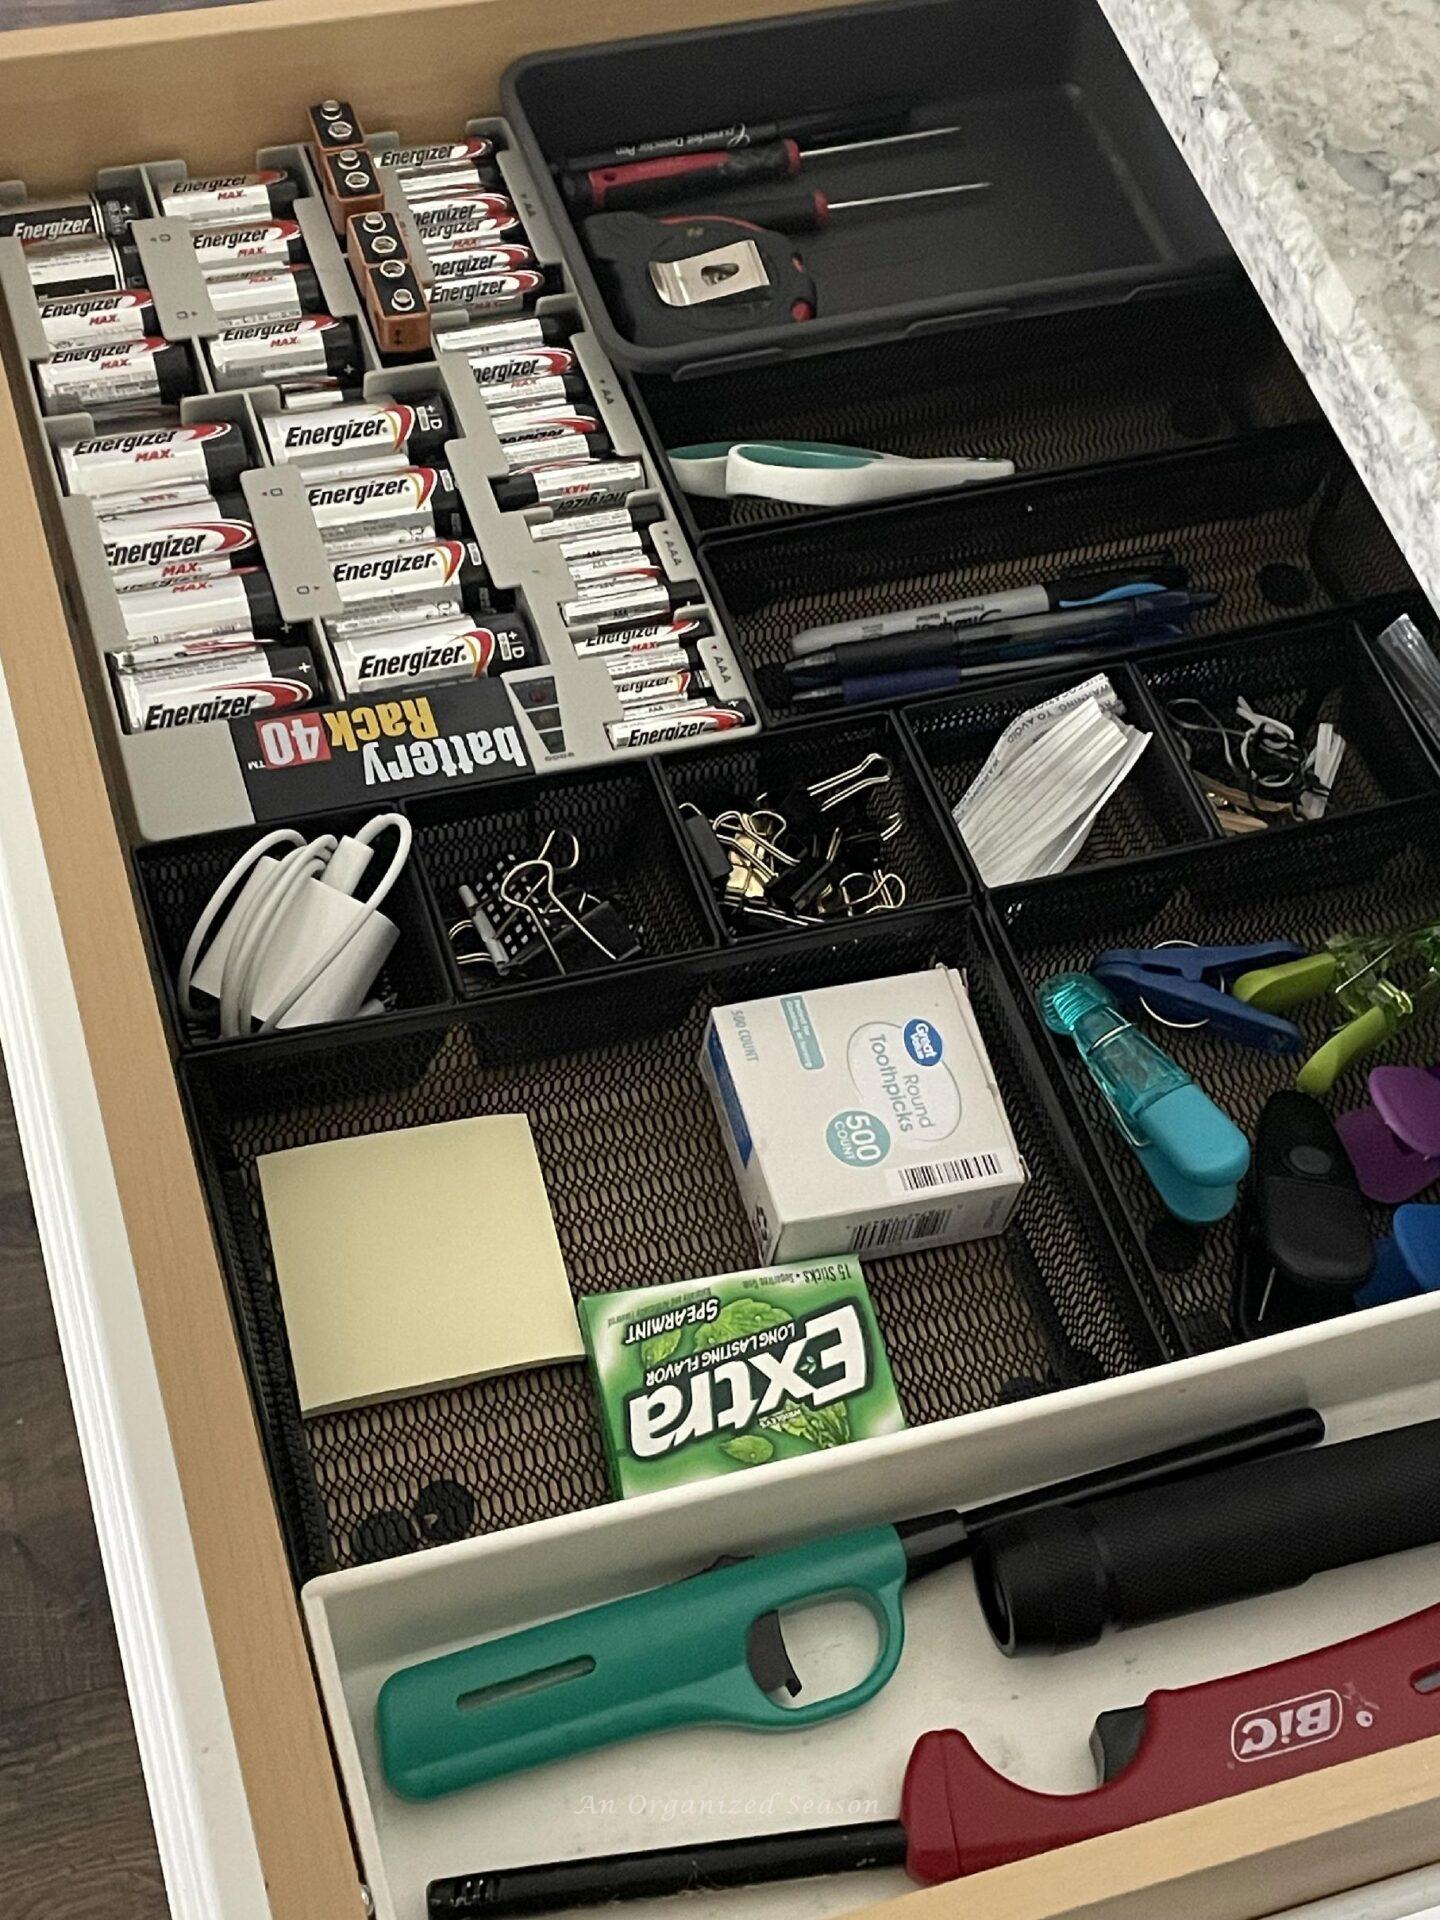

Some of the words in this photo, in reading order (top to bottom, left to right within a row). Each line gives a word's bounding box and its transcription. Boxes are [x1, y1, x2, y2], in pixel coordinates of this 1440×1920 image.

[380, 145, 455, 167] Energizer
[172, 175, 248, 194] Energizer
[12, 216, 92, 241] Energizer
[193, 227, 269, 249] Energizer
[419, 219, 482, 240] nergizer
[430, 254, 498, 278] nergizer
[429, 279, 507, 304] Energizer
[41, 295, 123, 319] Energizer
[222, 320, 303, 342] Energizer
[52, 343, 134, 365] Energizer
[472, 358, 540, 385] nergizer
[73, 429, 178, 456] Energizer
[285, 416, 386, 448] Energizer
[308, 477, 408, 507] Energizer
[104, 532, 207, 567] Energizer
[333, 550, 435, 583] Energizer
[586, 626, 660, 648] Energizer
[358, 643, 464, 680] Energizer
[713, 655, 733, 685] AAA
[614, 676, 669, 693] nergizer
[144, 692, 257, 731] Energizer
[323, 696, 439, 752] Rack
[1037, 711, 1053, 721] TO
[260, 719, 321, 767] 40
[628, 722, 706, 748] Energizer
[1007, 718, 1034, 744] AVOID
[363, 726, 528, 786] battery
[737, 1028, 759, 1062] COUNT
[914, 1022, 938, 1059] Great
[868, 1033, 914, 1133] Toothpicks
[903, 1074, 936, 1129] Round
[833, 1120, 857, 1161] COUNT
[846, 1114, 882, 1163] 500
[837, 1263, 852, 1280] 15
[624, 1298, 719, 1344] SPEARMINT
[760, 1322, 796, 1348] LONG
[706, 1335, 760, 1364] LASTING
[628, 1304, 868, 1458] Extra
[645, 1356, 699, 1386] FLAVOR
